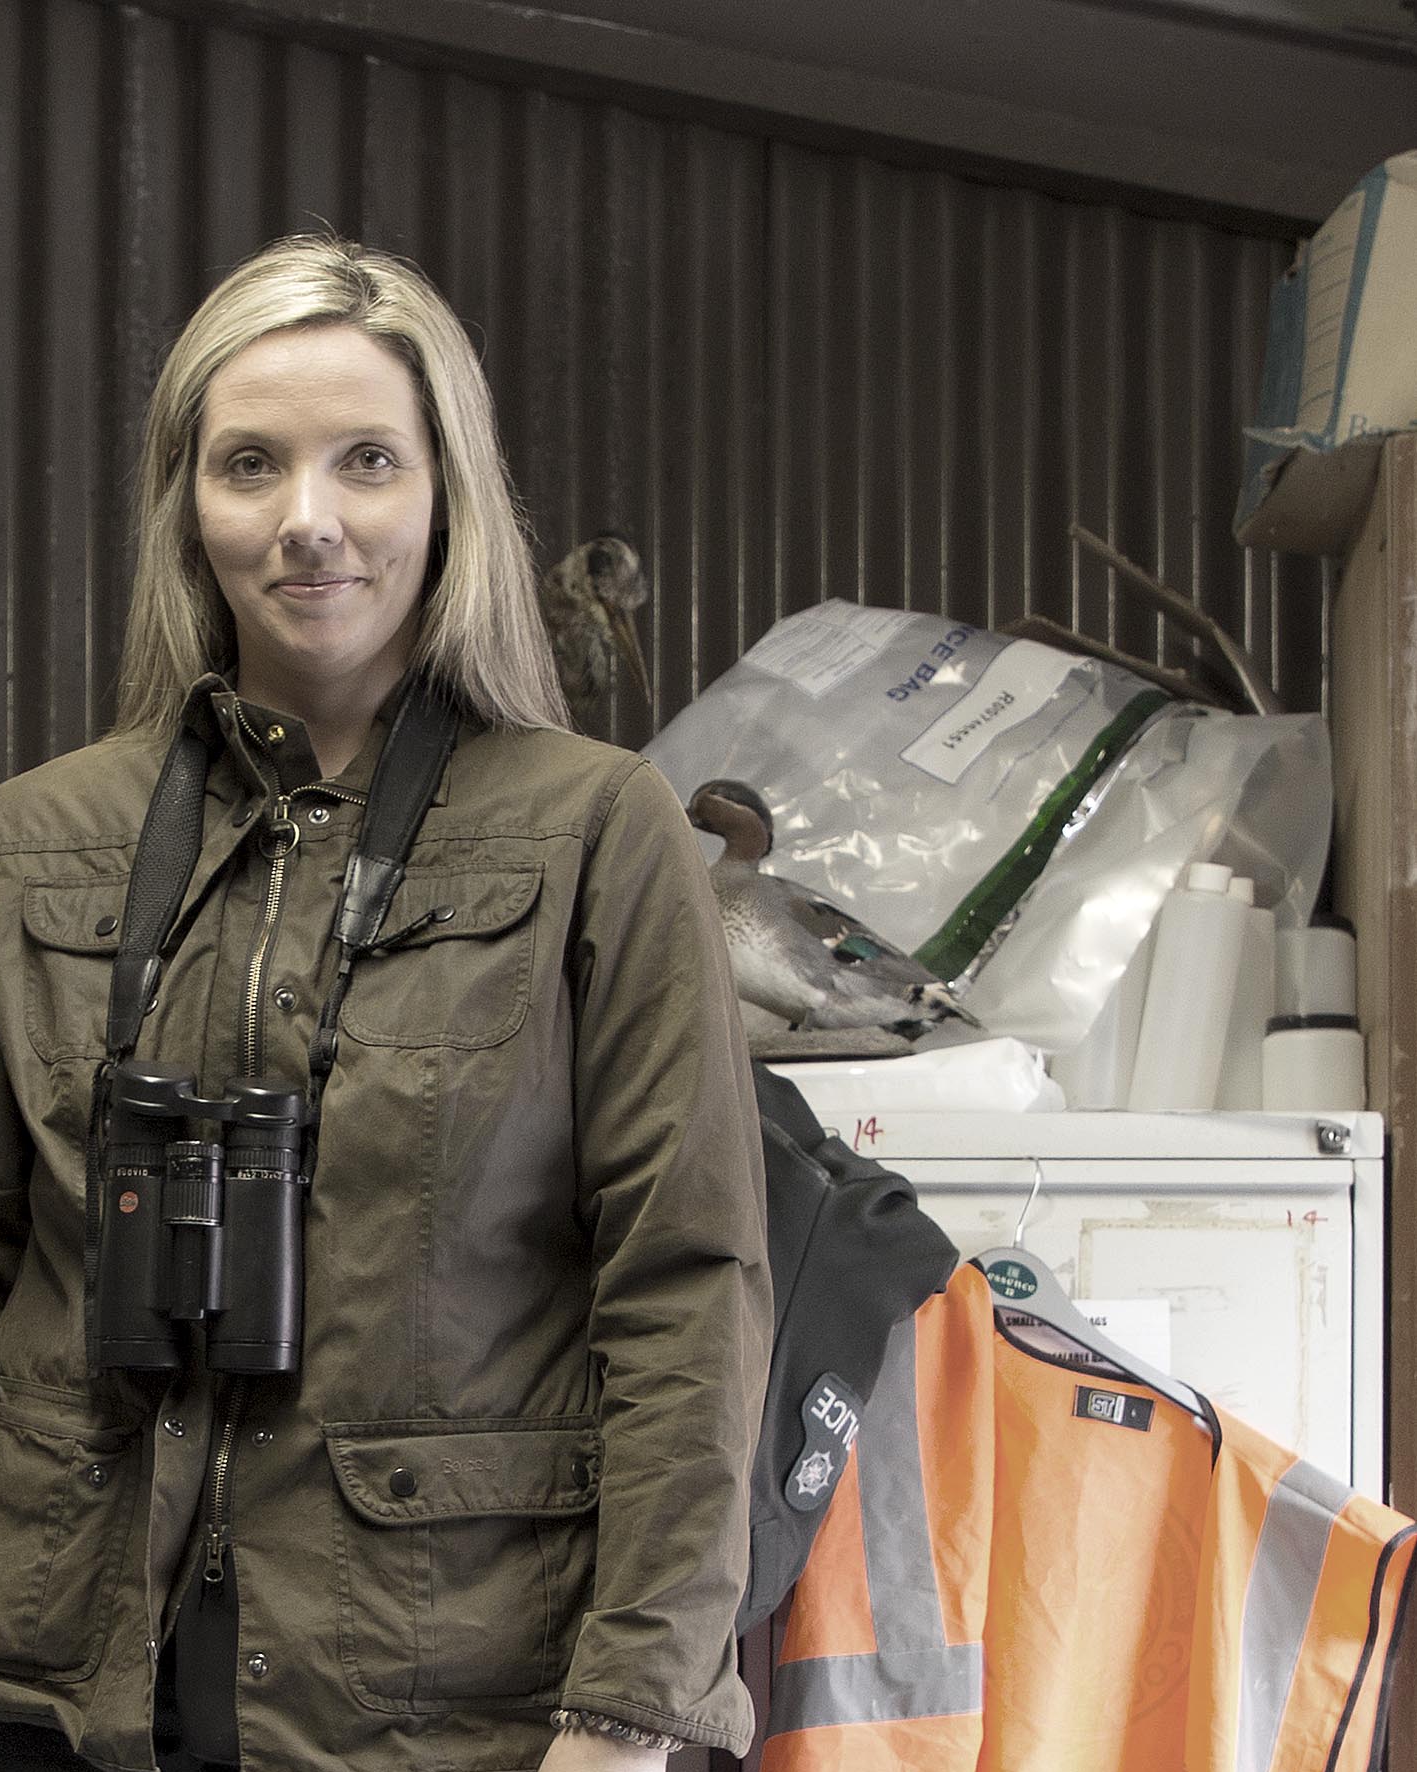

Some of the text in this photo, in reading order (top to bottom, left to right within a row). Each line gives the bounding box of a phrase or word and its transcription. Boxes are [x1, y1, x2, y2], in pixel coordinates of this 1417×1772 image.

[886, 663, 937, 702] BAG
[853, 1116, 884, 1152] 14
[1287, 1209, 1329, 1227] 14
[1005, 1316, 1035, 1327] SMALL
[1085, 1316, 1107, 1327] AGS
